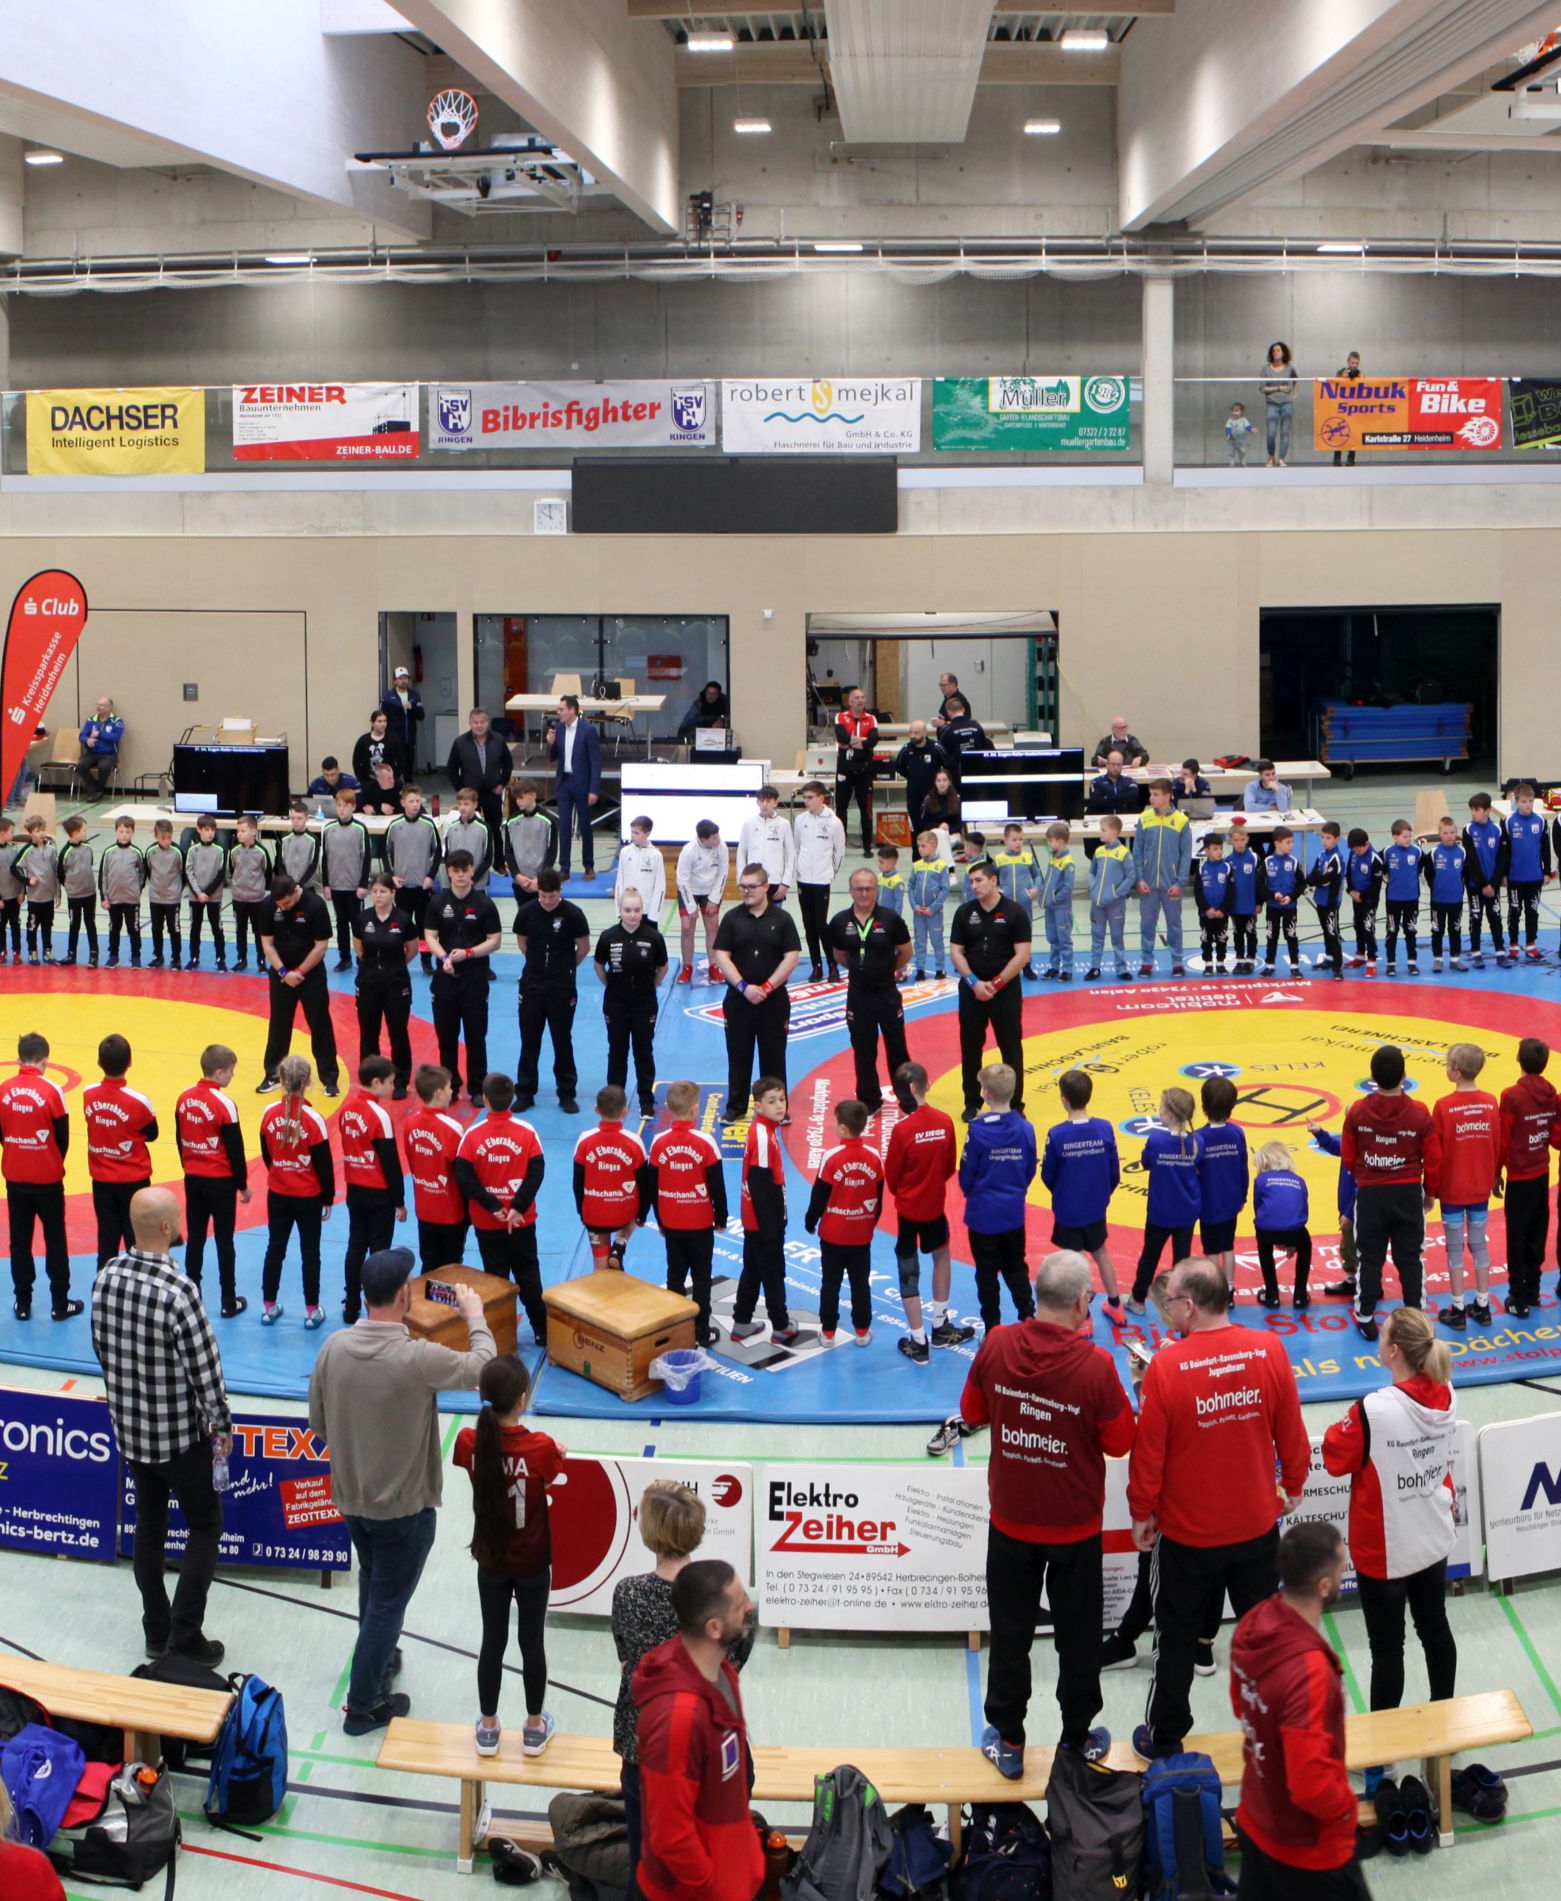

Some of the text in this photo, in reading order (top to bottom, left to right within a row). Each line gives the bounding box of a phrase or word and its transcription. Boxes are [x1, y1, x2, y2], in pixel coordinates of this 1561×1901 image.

[240, 386, 347, 405] ZEINER
[730, 383, 913, 407] robert mejkal
[1002, 386, 1067, 406] Müller
[1091, 384, 1120, 403] 1982
[1319, 382, 1407, 401] Nubuk
[239, 404, 321, 412] Bauunternehmen
[1338, 403, 1396, 417] Sports
[1420, 394, 1486, 414] Bike
[51, 404, 178, 431] DACHSER
[481, 398, 661, 433] Bibrisfighter
[52, 436, 179, 450] Intelligent Logistics
[438, 436, 473, 444] RINGEN
[846, 431, 872, 439] GmbH
[1365, 435, 1451, 444] Karlstraße 27 Heidenheim
[336, 445, 412, 455] ZEINER-BAU.DE
[837, 441, 854, 450] Bau
[856, 441, 872, 450] und
[41, 598, 80, 616] Club
[22, 631, 62, 707] Kreissparkasse
[34, 652, 66, 714] Heidenheim
[488, 1153, 510, 1164] Ringen
[598, 1161, 621, 1172] Ringen
[1208, 1362, 1246, 1378] Jugendteam
[1196, 1386, 1262, 1414] bohmeier.
[1020, 1402, 1052, 1422] Ringen
[1002, 1424, 1068, 1455] bohmeier.
[294, 1478, 324, 1490] Verkauf
[906, 1484, 930, 1498] Elektro
[295, 1488, 326, 1500] auf dem
[768, 1481, 859, 1521] Elektro
[12, 1506, 100, 1530] Herbrechtingen
[287, 1508, 341, 1525] ZEOTTEXX
[906, 1506, 930, 1518] Elektro
[785, 1511, 896, 1541] Zeiher
[274, 1547, 348, 1562] 73 24 98 29 90
[866, 1546, 898, 1554] GmbH
[776, 1570, 794, 1578] den
[797, 1570, 846, 1582] Stegwiesen
[887, 1586, 904, 1595] Fax
